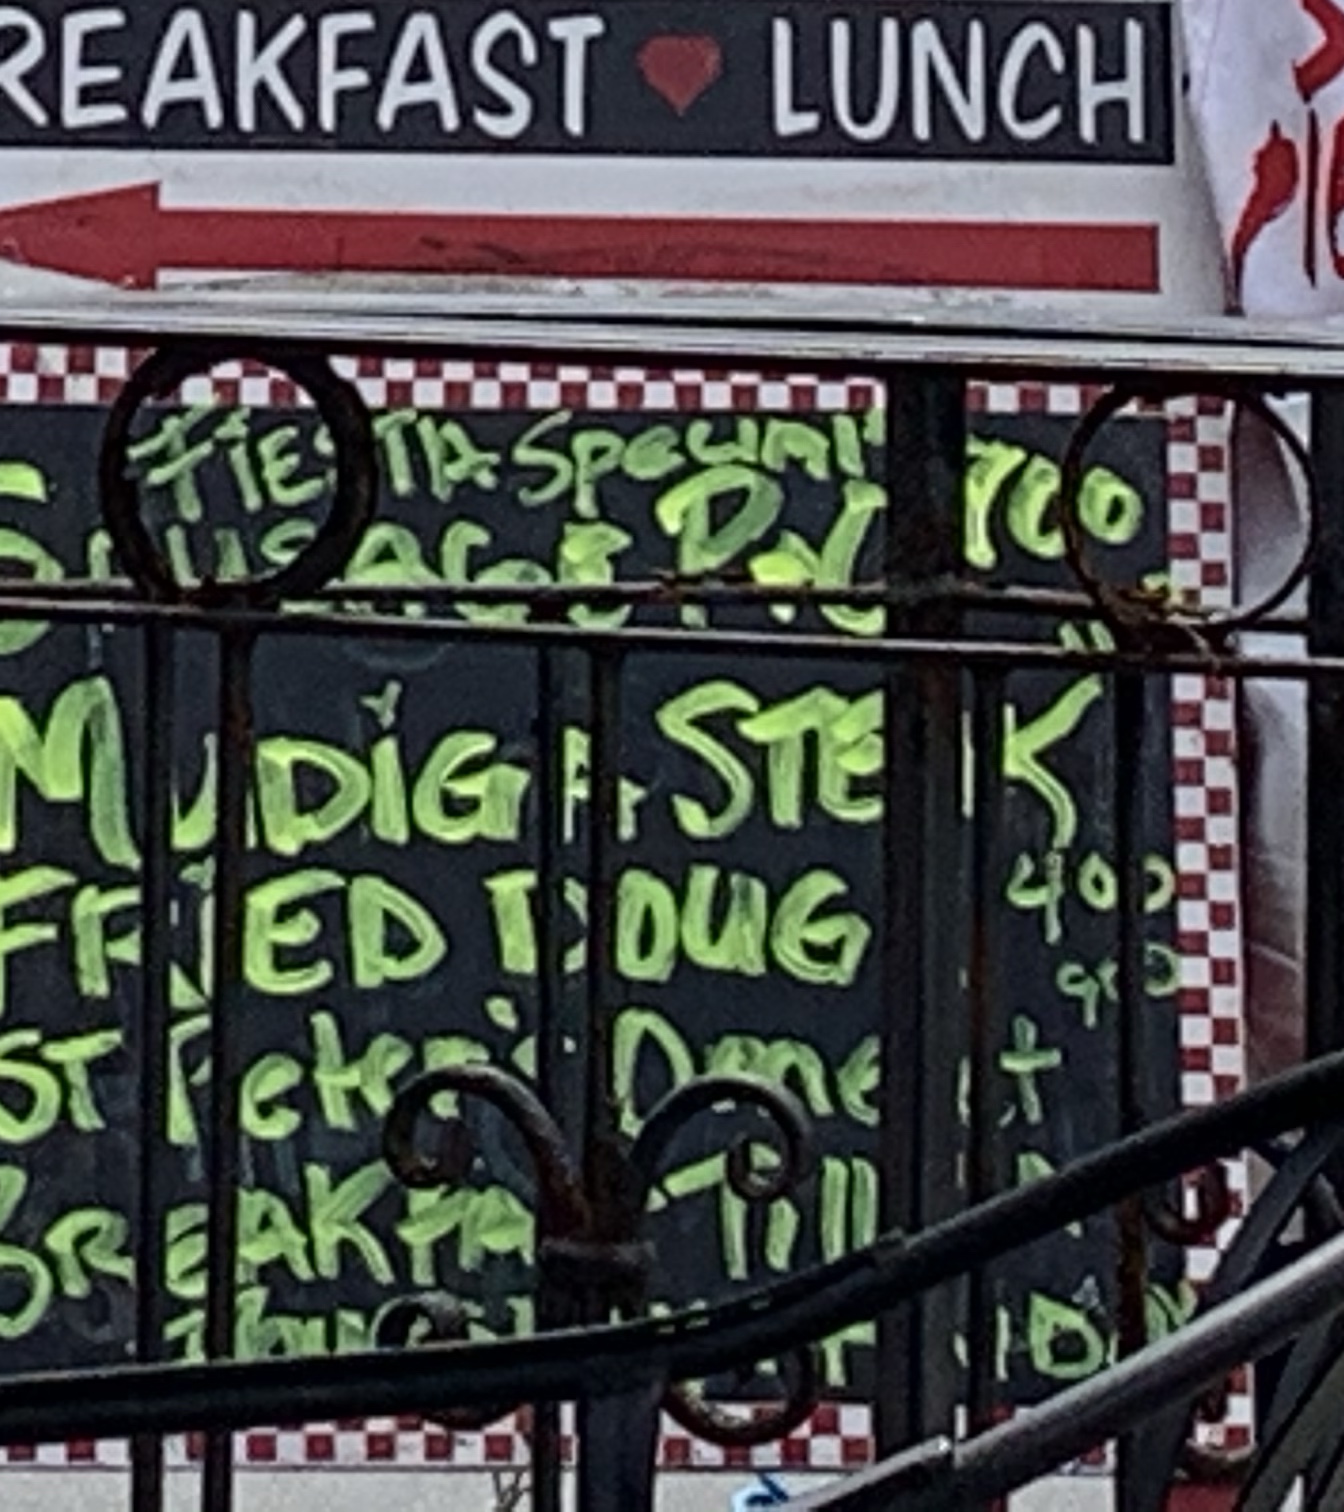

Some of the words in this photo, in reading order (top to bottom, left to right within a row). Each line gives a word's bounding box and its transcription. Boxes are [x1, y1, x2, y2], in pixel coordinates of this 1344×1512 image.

[773, 14, 1146, 144] LUNCH
[126, 394, 501, 522] FIETA
[656, 676, 1105, 848] STEK
[483, 863, 876, 987] DOUG
